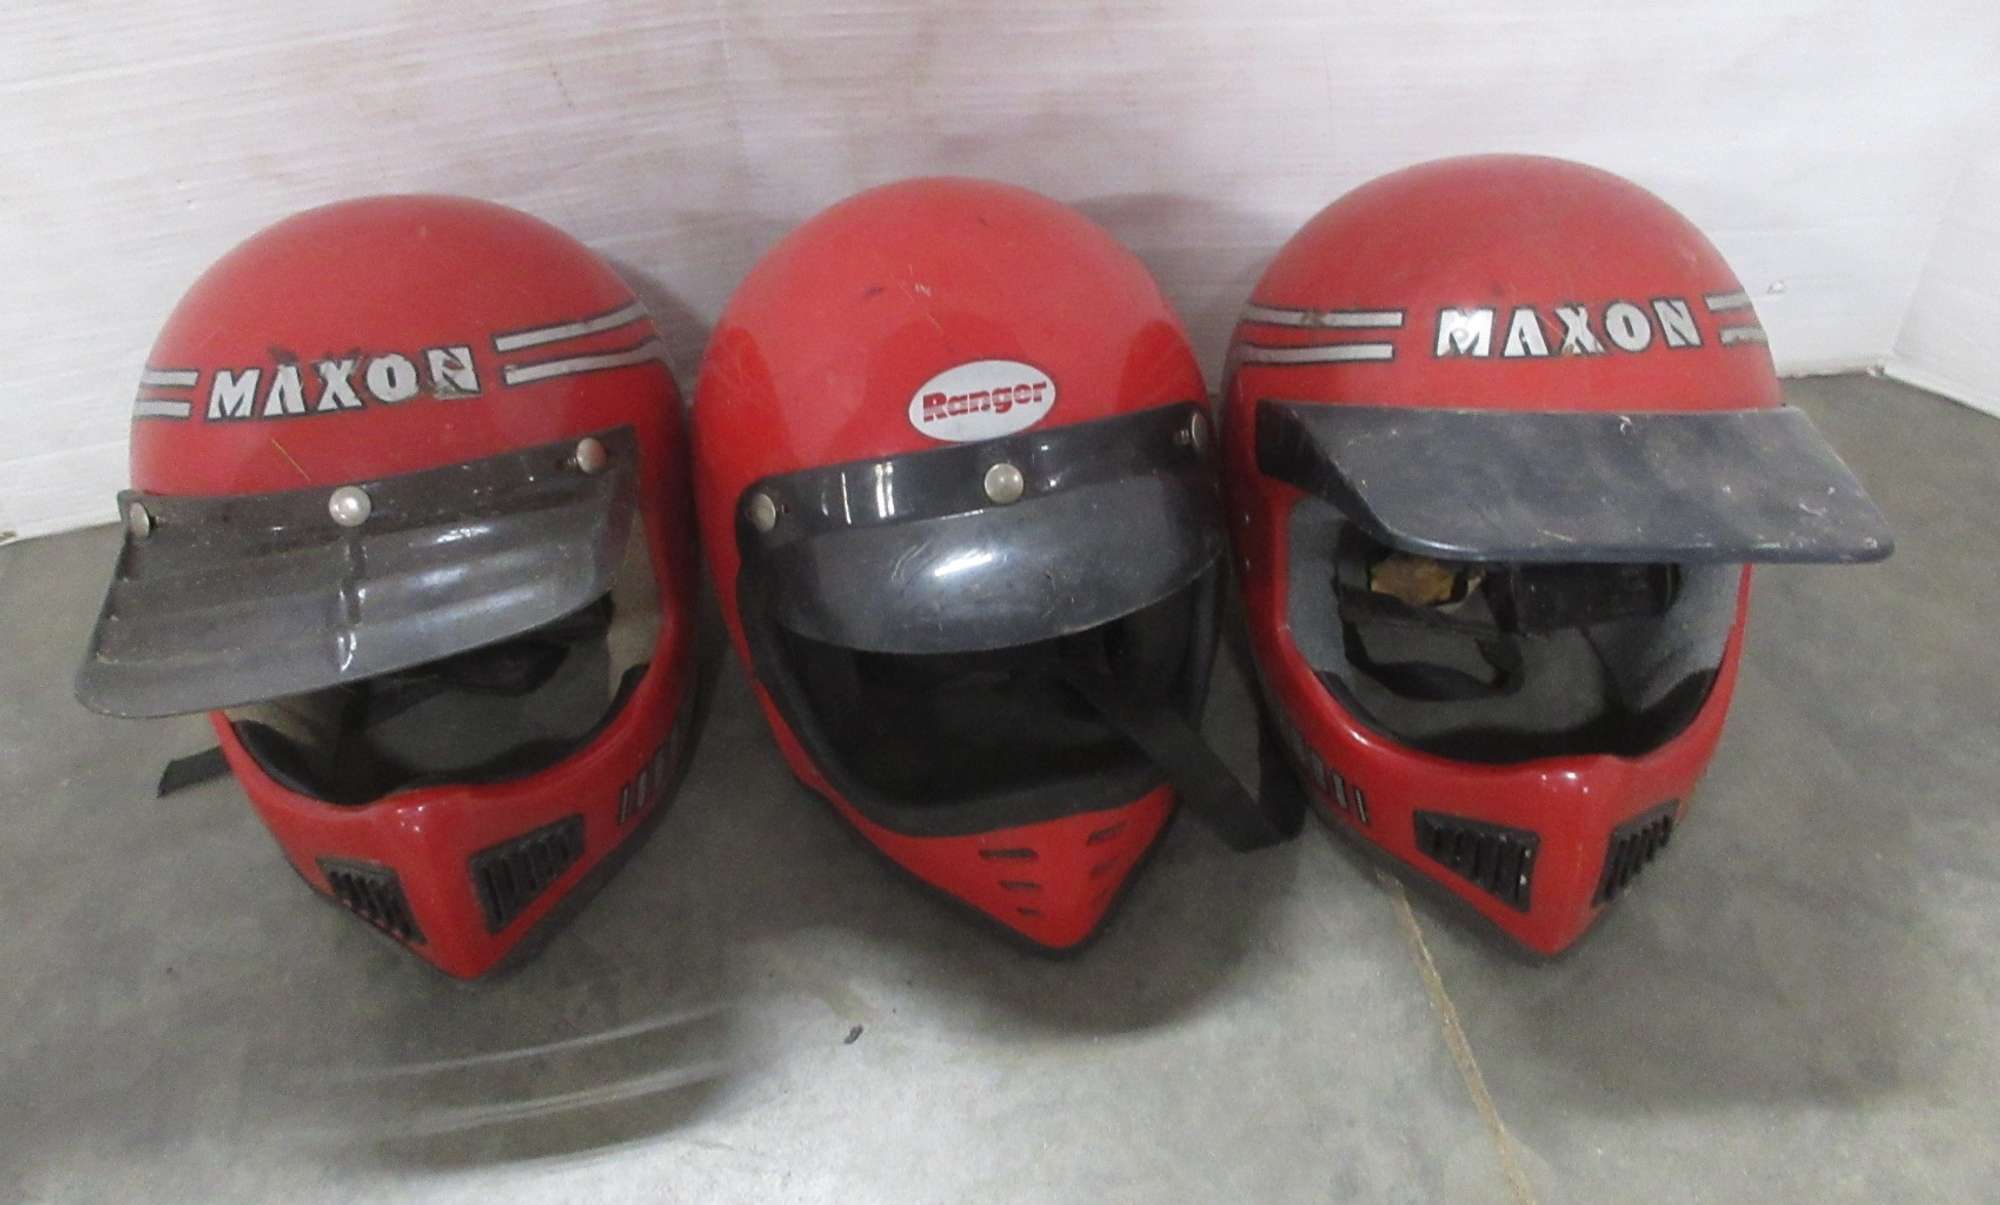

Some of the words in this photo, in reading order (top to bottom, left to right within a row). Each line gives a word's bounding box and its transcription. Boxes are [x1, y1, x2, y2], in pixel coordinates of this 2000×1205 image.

[1435, 298, 1703, 358] MAXON
[206, 346, 481, 421] MAXON
[922, 380, 1047, 423] Ranger
